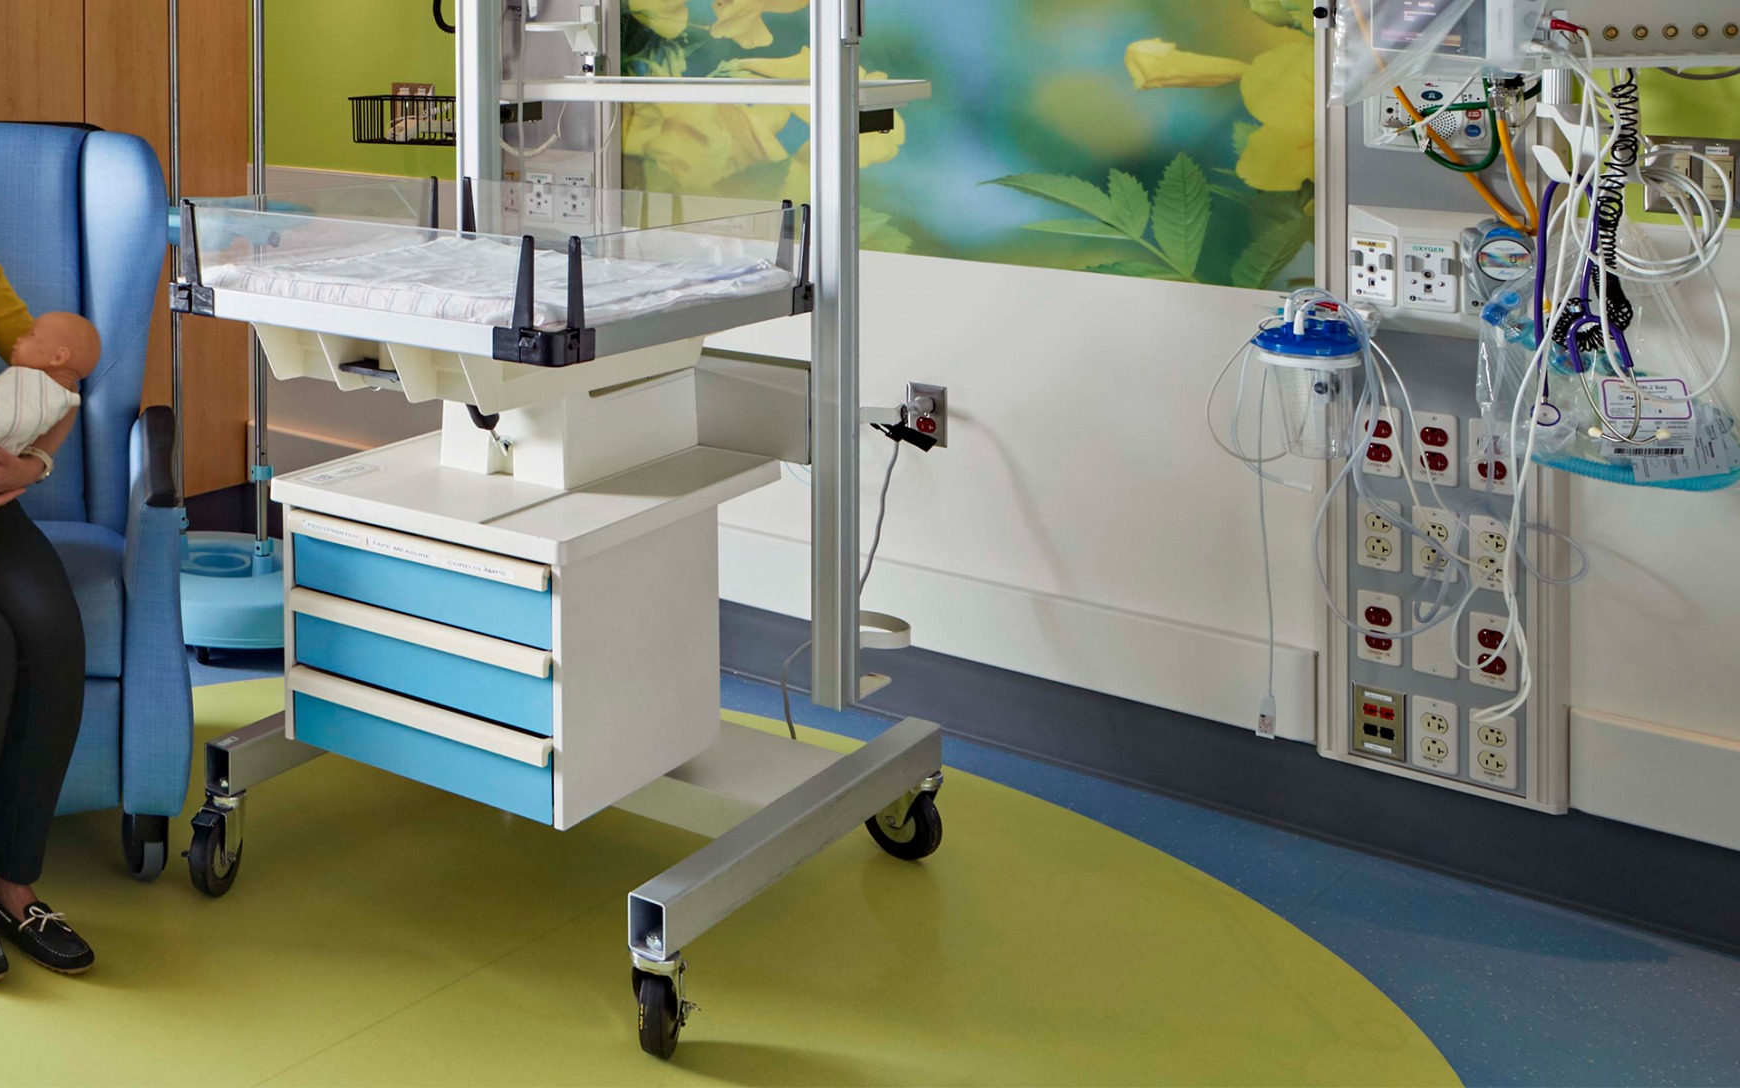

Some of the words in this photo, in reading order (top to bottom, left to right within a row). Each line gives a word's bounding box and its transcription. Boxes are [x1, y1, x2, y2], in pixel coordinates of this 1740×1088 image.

[1412, 245, 1444, 253] OXYGEN
[307, 522, 359, 540] FOOTPRINTER
[371, 540, 392, 551] TAPE
[393, 545, 431, 559] MEASURE
[447, 560, 471, 570] CORD
[472, 565, 507, 577] CLAMPS
